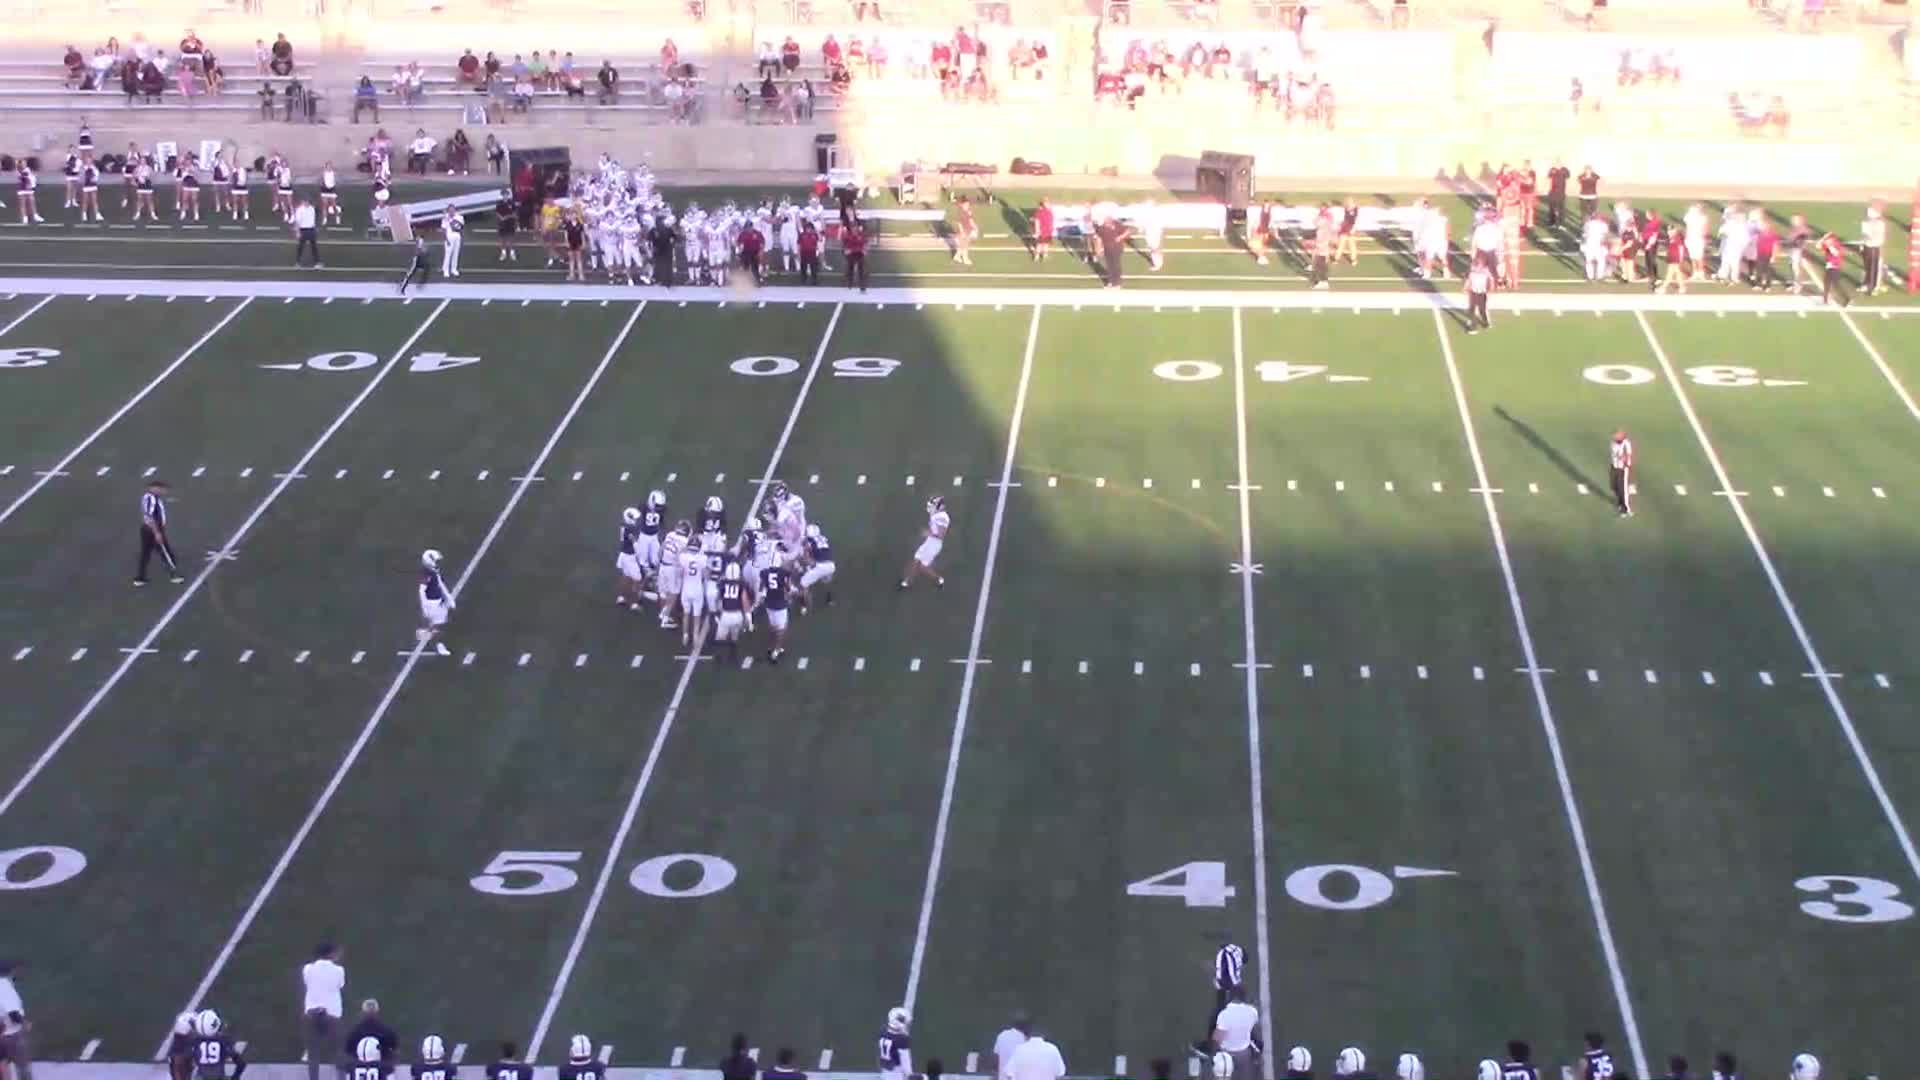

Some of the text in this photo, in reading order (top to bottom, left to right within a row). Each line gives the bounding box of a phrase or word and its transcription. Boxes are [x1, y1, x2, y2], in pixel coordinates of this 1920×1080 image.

[688, 561, 698, 576] 5
[723, 583, 740, 599] 10
[767, 572, 779, 590] 5
[469, 851, 737, 898] 50
[1126, 861, 1395, 910] 40
[1794, 875, 1914, 923] 3
[199, 1041, 221, 1065] 19
